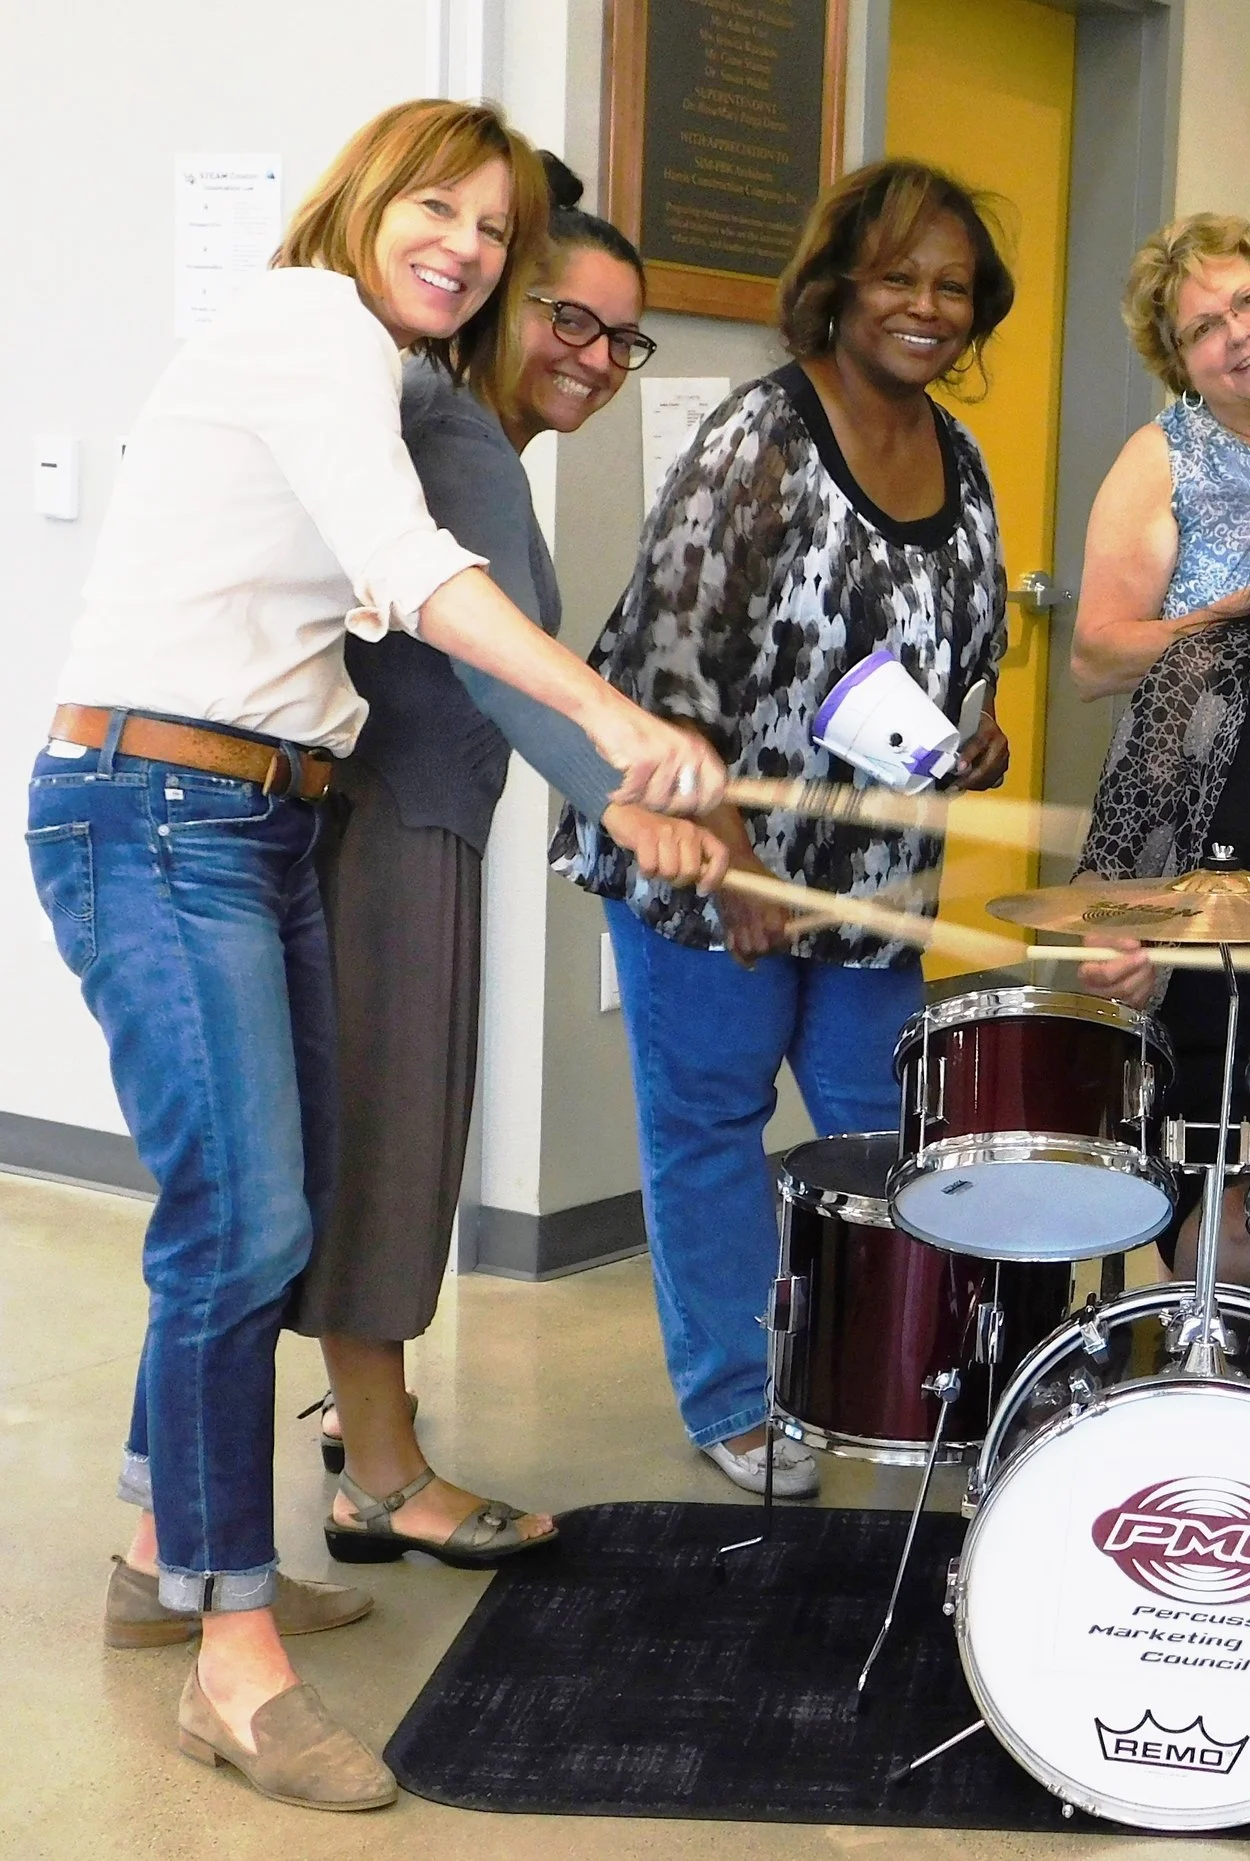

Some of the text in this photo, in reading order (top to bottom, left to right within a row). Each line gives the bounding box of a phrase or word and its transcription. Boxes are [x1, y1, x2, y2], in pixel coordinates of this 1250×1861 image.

[1088, 1624, 1243, 1651] Marketing
[1139, 1650, 1250, 1671] Council
[1113, 1737, 1224, 1767] REMO
